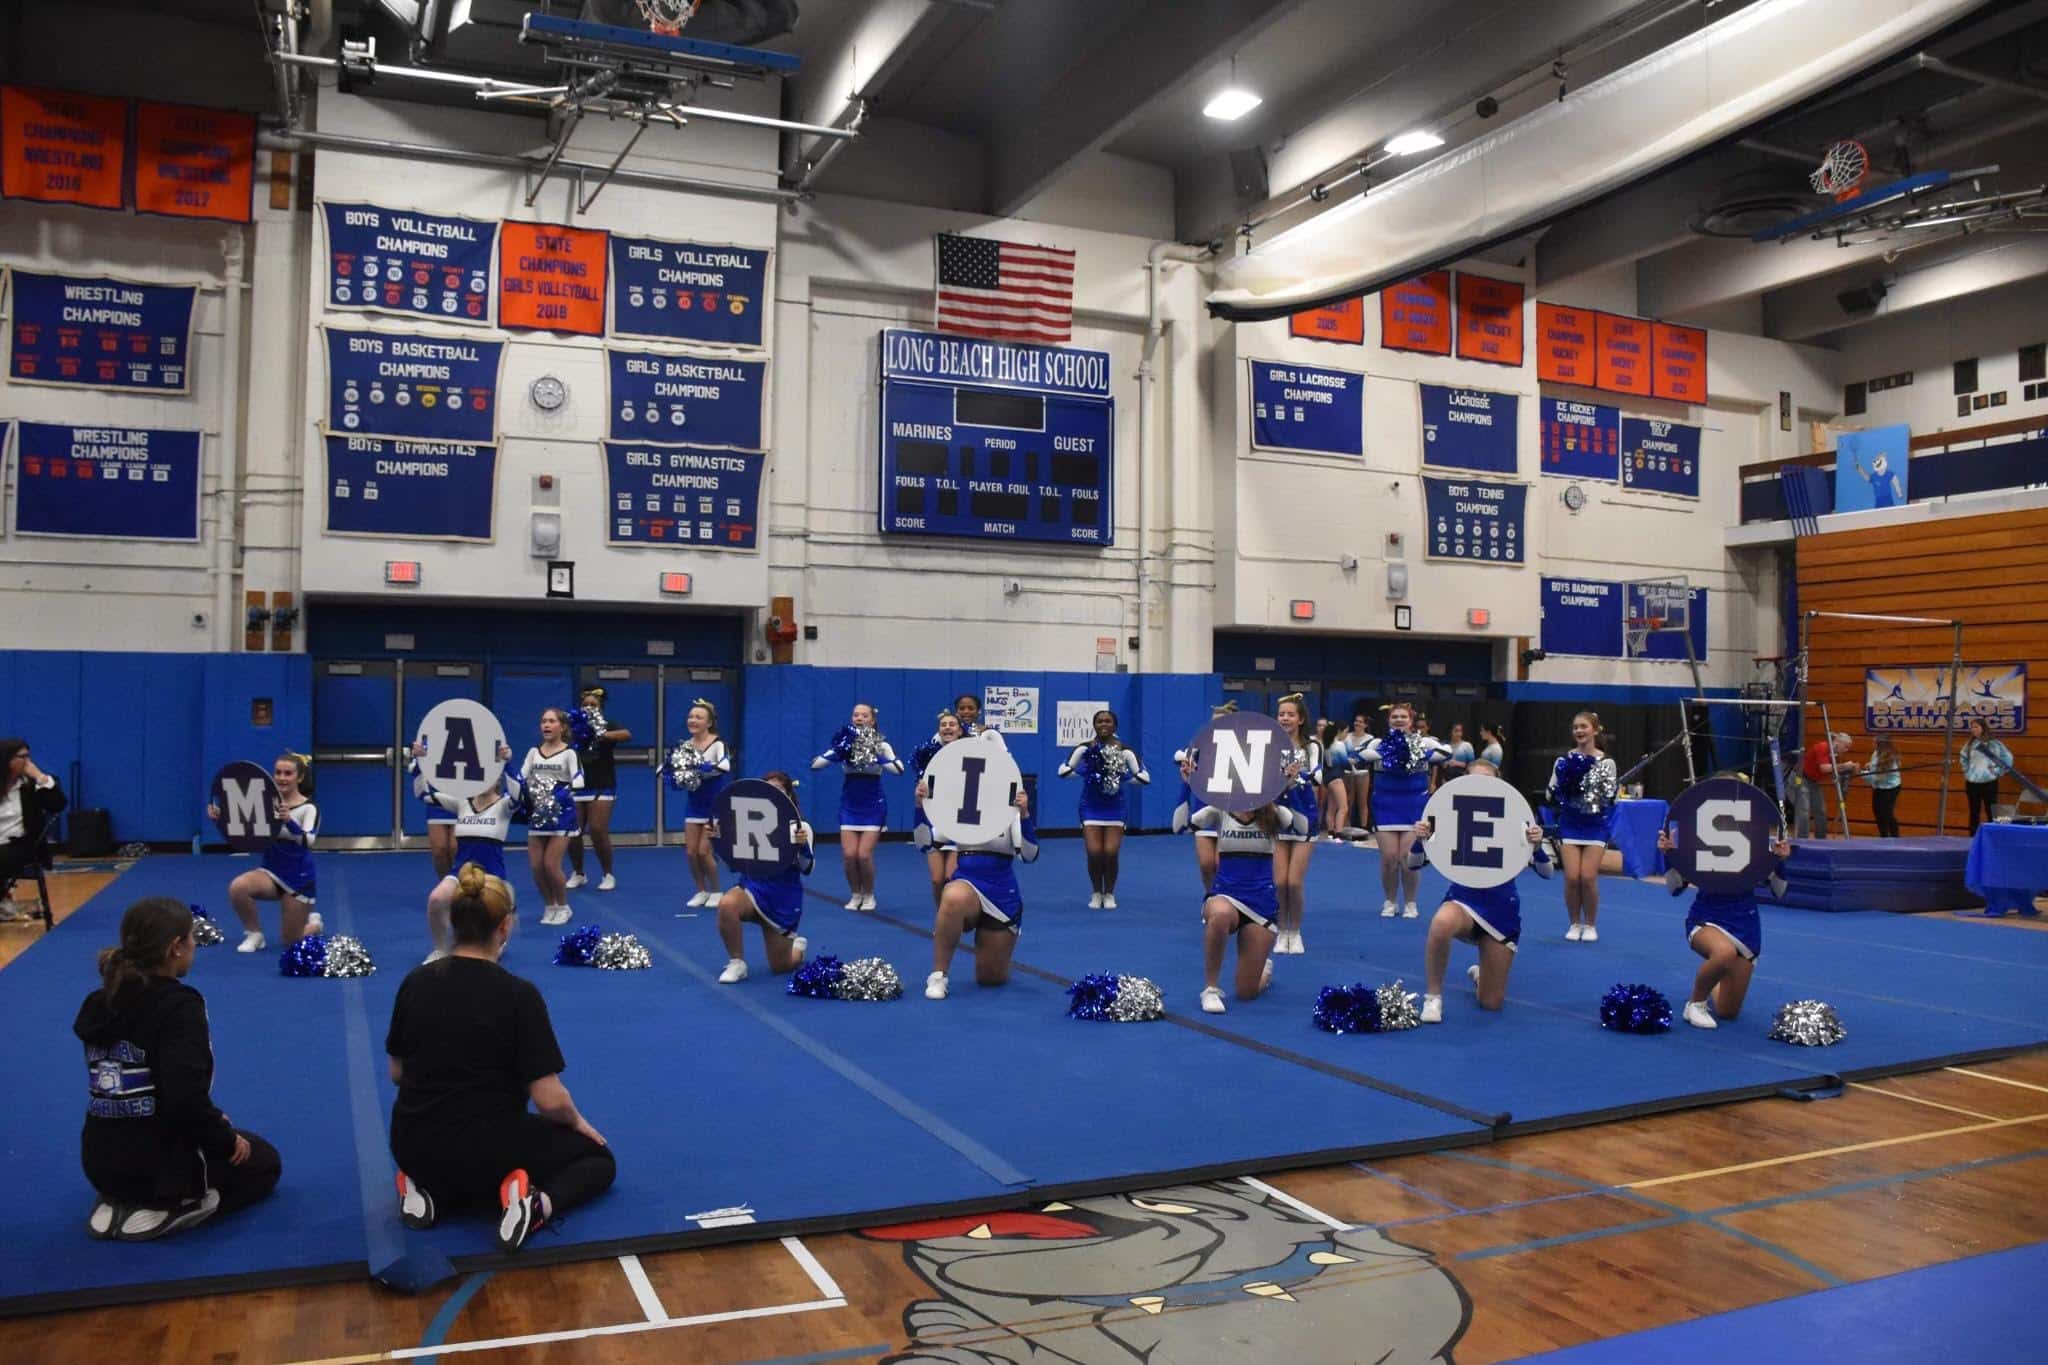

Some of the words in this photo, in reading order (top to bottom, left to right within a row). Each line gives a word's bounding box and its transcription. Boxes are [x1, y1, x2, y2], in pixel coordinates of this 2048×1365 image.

[345, 211, 379, 227] BOYS
[392, 217, 476, 241] VOLLEYBALL
[376, 236, 448, 259] CHAMPIONS
[536, 235, 573, 253] STATE
[519, 256, 587, 277] CHAMPIONS
[629, 246, 662, 262] GIRLS
[675, 251, 752, 269] VOLLEYBALL
[658, 268, 723, 287] CHAMPIONS
[64, 285, 144, 306] WRESTLING
[504, 278, 533, 294] GIRLS
[538, 281, 600, 302] VOLLEYBALL
[63, 307, 142, 327] CHAMPIONS
[349, 338, 383, 354] BOYS
[392, 342, 479, 361] BASKETBALL
[379, 362, 450, 380] CHAMPIONS
[626, 360, 659, 375] GIRLS
[666, 363, 746, 382] BASKETBALL
[888, 336, 934, 374] LONG
[939, 339, 993, 379] BEACH
[998, 346, 1041, 384] HIGH
[1045, 351, 1107, 390] SCHOOL
[1270, 370, 1296, 383] GIRLS
[1299, 373, 1347, 389] LACROSSE
[655, 382, 720, 399] CHAMPIONS
[1284, 388, 1333, 404] CHAMPIONS
[1449, 394, 1491, 410] LACROSSE
[1556, 401, 1567, 411] ICE
[1570, 403, 1596, 415] HOCKEY
[1449, 410, 1492, 426] CHAMPIONS
[1557, 412, 1596, 426] CHAMPIONS
[72, 428, 148, 446] WRESTLING
[892, 422, 952, 441] MARINES
[71, 444, 148, 461] CHAMPIONS
[348, 438, 382, 452] BOYS
[394, 441, 477, 457] GYMNASTICS
[984, 438, 1016, 450] PERIOD
[1054, 436, 1094, 453] GUEST
[1642, 439, 1678, 453] CHAMPIONS
[376, 460, 448, 476] CHAMPIONS
[626, 452, 662, 467] GIRLS
[670, 454, 746, 472] GYMNASTICS
[652, 473, 719, 490] CHAMPIONS
[895, 476, 925, 488] FOULS
[936, 478, 960, 490] T.O.L.
[969, 480, 1003, 493] PLAYER
[1008, 483, 1030, 495] FOUL
[1039, 485, 1062, 498] T.O.L.
[1072, 488, 1099, 500] FOULS
[1448, 485, 1469, 497] BOYS
[1477, 487, 1504, 499] TENNIS
[1456, 502, 1498, 516] CHAMPIONS
[895, 517, 926, 529] SCORE
[984, 522, 1015, 534] MATCH
[1071, 528, 1099, 540] SCORE
[1552, 581, 1570, 592] BOYS
[1571, 584, 1608, 595] BADMINTON
[1560, 595, 1599, 607] CHAMPIONS
[436, 717, 484, 782] A
[1207, 729, 1272, 794] N
[957, 757, 986, 825] I
[222, 778, 271, 837] M
[730, 796, 780, 862] R
[1451, 794, 1504, 869] E
[1696, 799, 1751, 873] S
